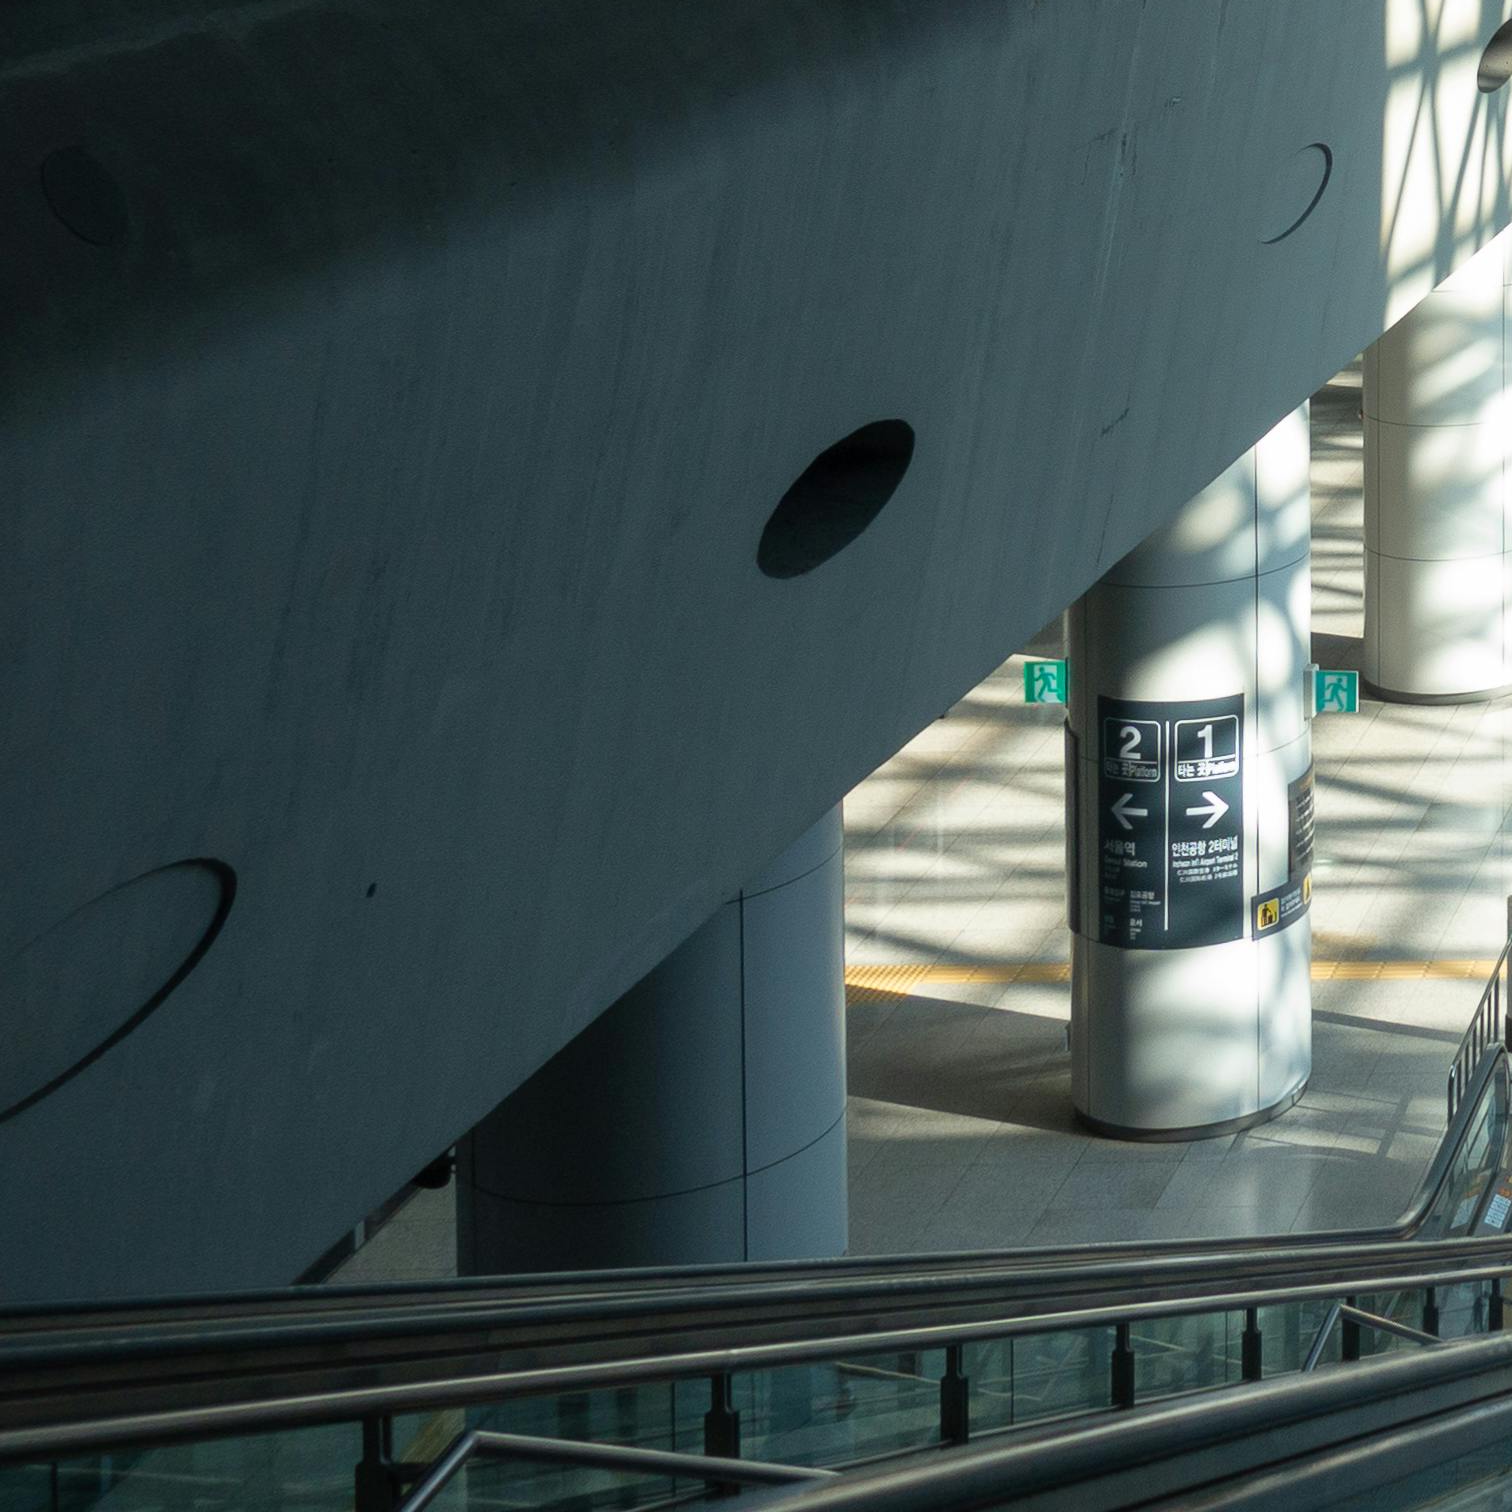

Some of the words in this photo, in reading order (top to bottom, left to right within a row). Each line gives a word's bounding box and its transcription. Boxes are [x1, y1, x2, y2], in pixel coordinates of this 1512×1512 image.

[1119, 725, 1142, 760] 2
[1197, 724, 1213, 758] 1
[1171, 840, 1207, 857] 인천공항
[1208, 835, 1239, 853] 2터미널
[1122, 858, 1148, 869] Station
